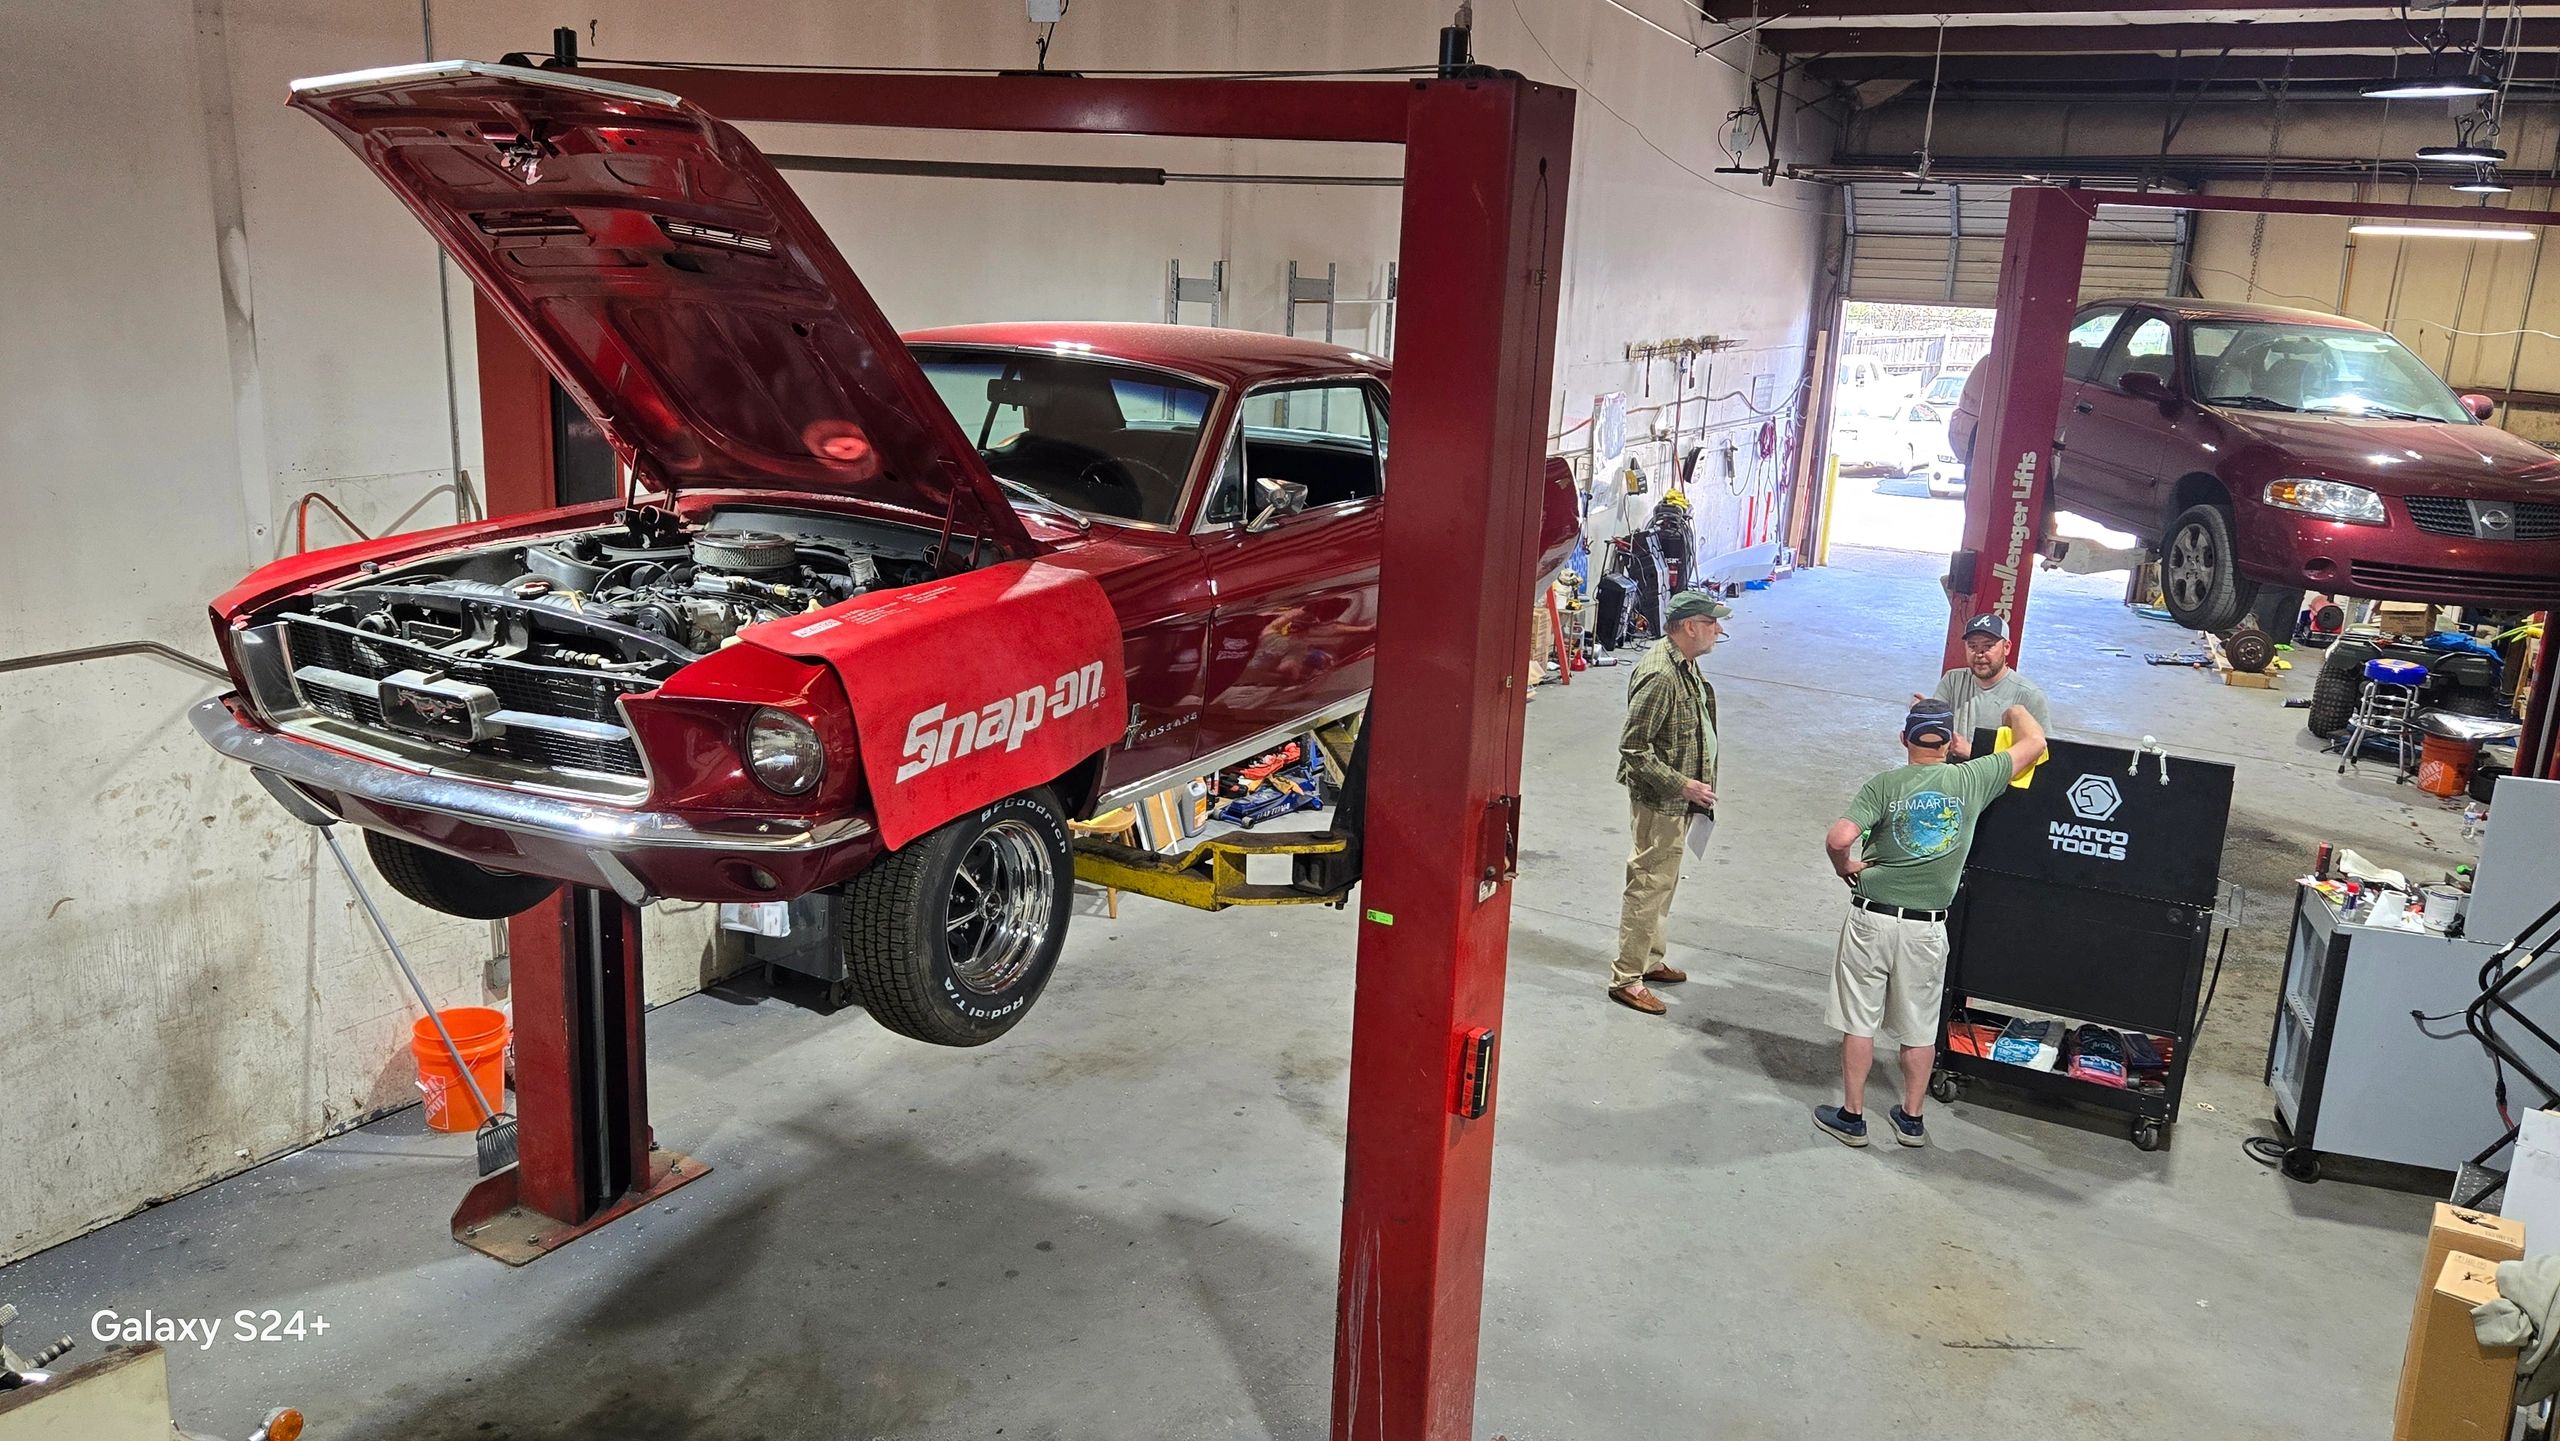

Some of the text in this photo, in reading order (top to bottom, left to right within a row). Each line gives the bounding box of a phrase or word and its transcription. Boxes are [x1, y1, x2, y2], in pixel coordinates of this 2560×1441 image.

[1992, 450, 2037, 625] Challenger Lifts
[895, 660, 1103, 784] Snap-on
[981, 797, 1067, 853] BFGoodrich
[2048, 834, 2127, 861] TOOLS
[2049, 820, 2129, 846] MATCO
[944, 976, 1024, 1020] Radial T/A
